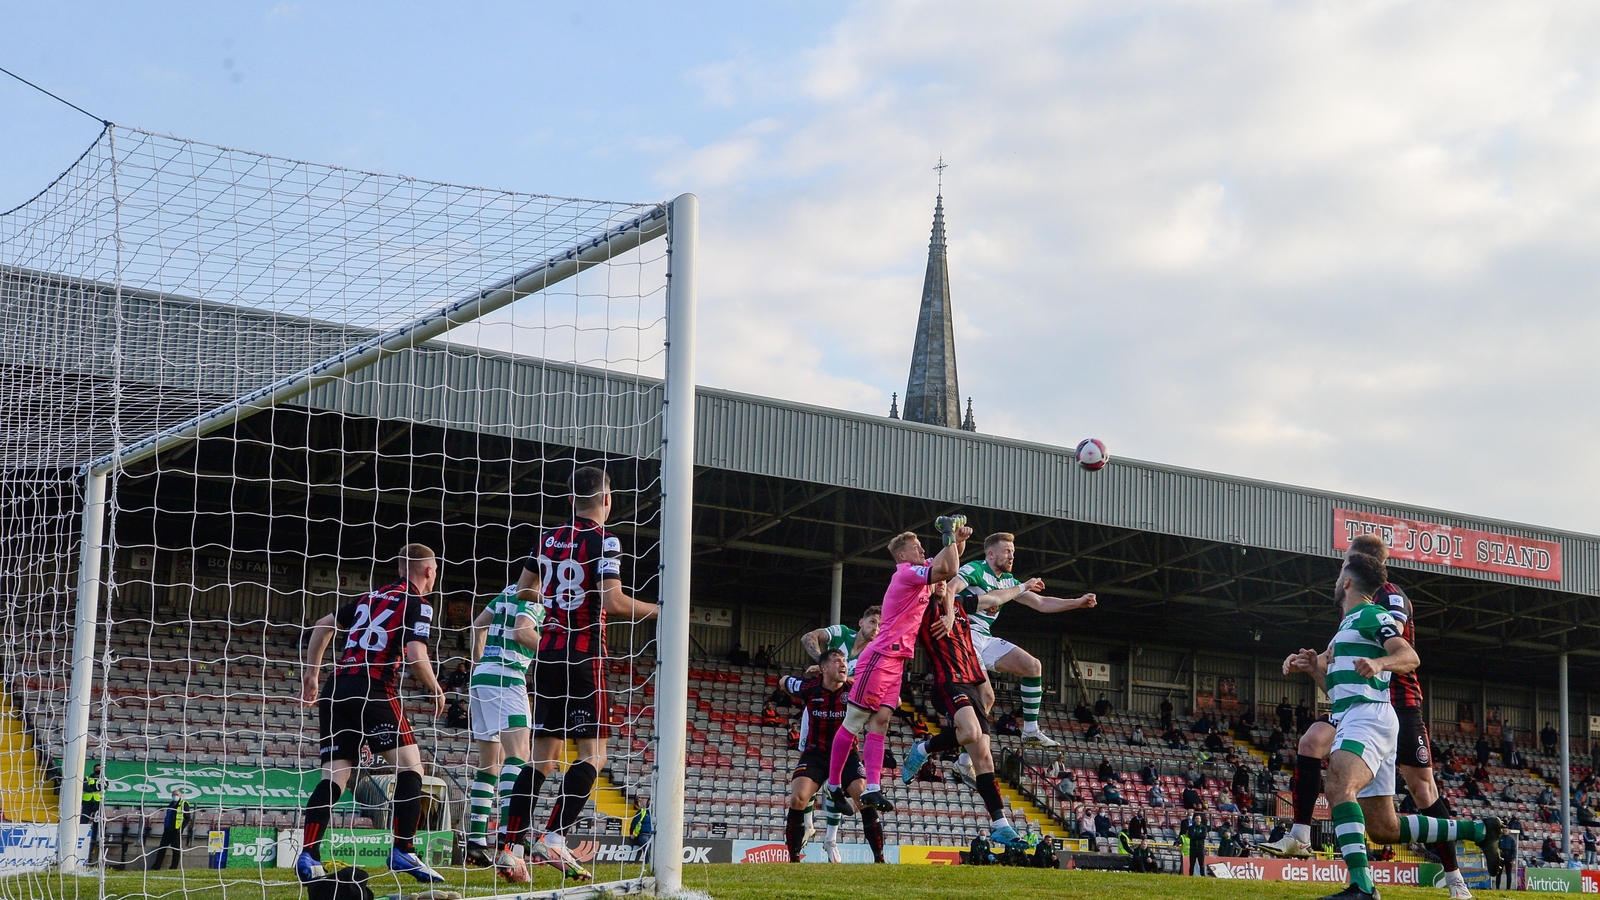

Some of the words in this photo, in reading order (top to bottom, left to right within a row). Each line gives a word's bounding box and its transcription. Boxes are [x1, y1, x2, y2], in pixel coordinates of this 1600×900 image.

[1345, 519, 1393, 548] THE
[1405, 529, 1462, 559] JODI
[1476, 540, 1551, 571] STAND
[139, 558, 147, 567] B
[207, 557, 243, 571] BOHS
[246, 560, 290, 576] FAMILY
[340, 576, 348, 587] B
[538, 555, 586, 611] 28
[704, 612, 711, 622] C
[344, 603, 395, 652] 26
[1087, 668, 1093, 677] D
[812, 709, 828, 718] des
[829, 710, 847, 718] kell
[1417, 735, 1424, 745] 6
[156, 767, 222, 779] Time
[225, 770, 254, 779] to
[1315, 796, 1330, 809] elly
[331, 833, 383, 845] Discover
[329, 848, 356, 858] with
[748, 849, 791, 863] BEATYAR
[1226, 861, 1264, 880] kelly
[1281, 864, 1308, 881] des
[1312, 864, 1348, 883] kelly
[1367, 866, 1391, 883] des
[1525, 876, 1571, 893] Airtricity
[1581, 876, 1599, 893] ills
